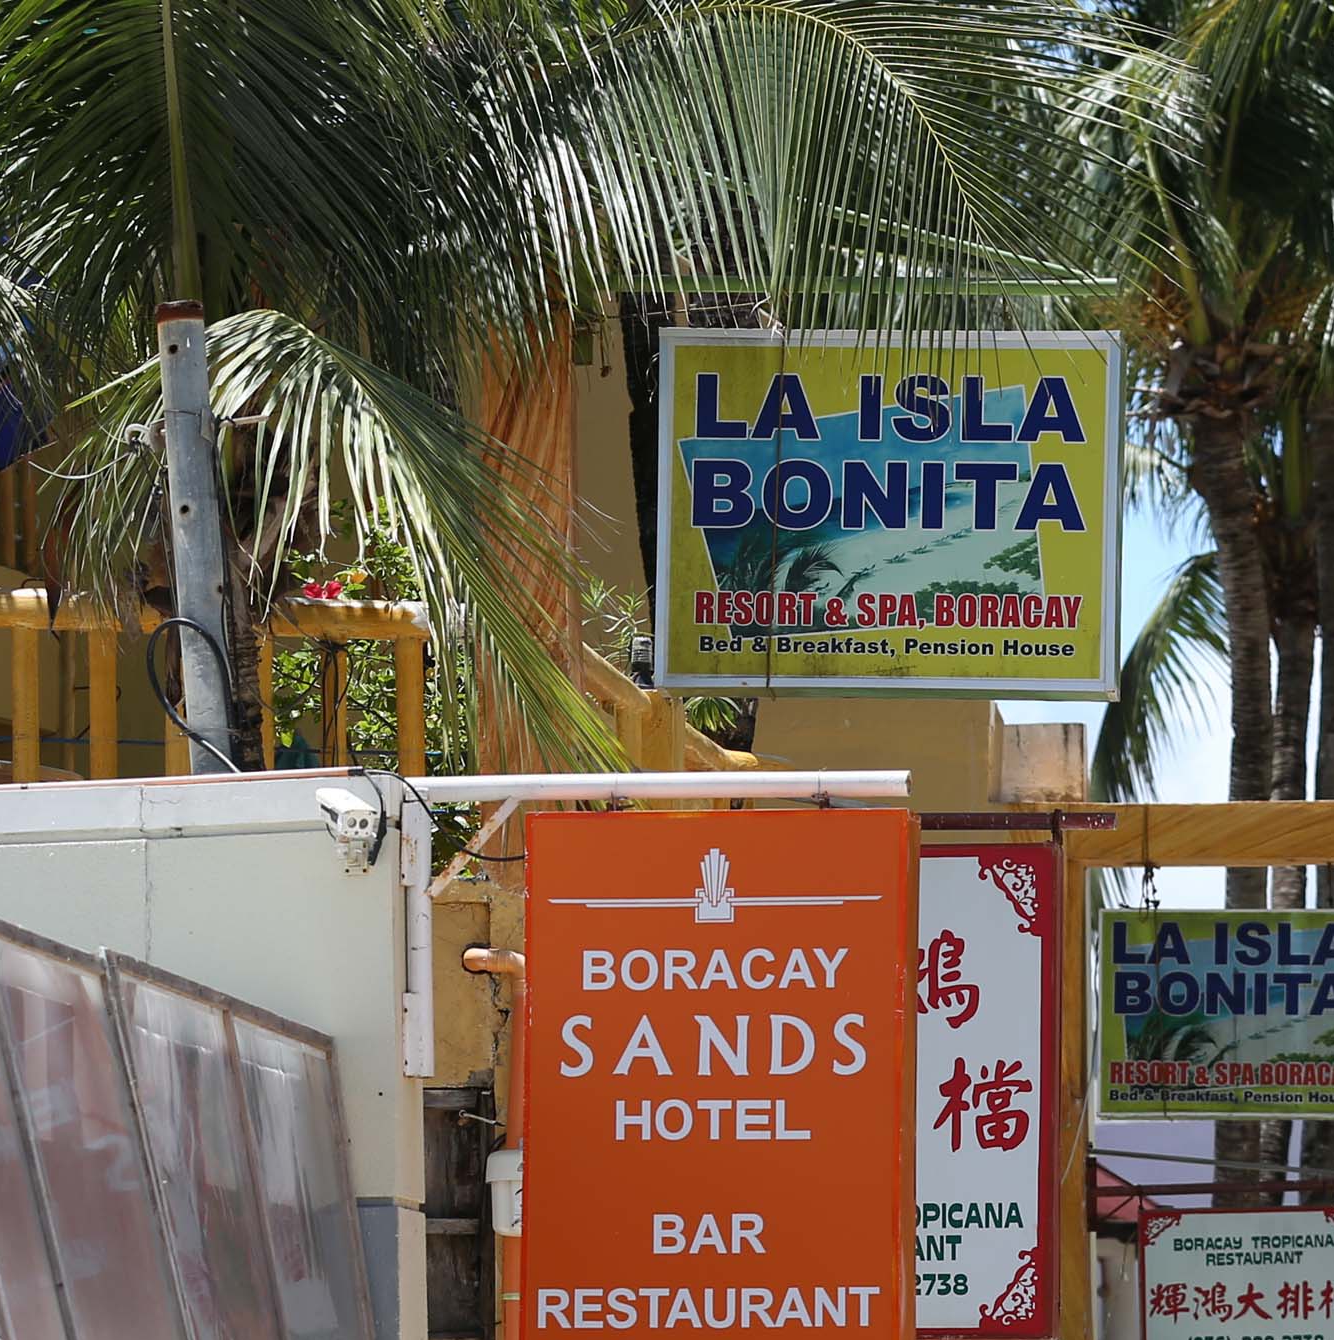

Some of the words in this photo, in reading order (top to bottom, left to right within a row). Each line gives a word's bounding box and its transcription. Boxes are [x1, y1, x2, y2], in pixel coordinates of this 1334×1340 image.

[695, 373, 820, 441] LA
[859, 373, 1086, 443] ISLA
[692, 459, 1086, 532] BONITA
[694, 591, 818, 626] RESORT
[824, 596, 847, 627] &
[857, 593, 926, 630] SPA,
[932, 595, 1082, 628] BORACAY
[699, 636, 742, 652] Bed
[751, 637, 767, 653] &
[776, 637, 896, 657] Breakfast,
[904, 639, 995, 657] Pension
[1002, 640, 1075, 657] House
[1113, 922, 1189, 965] LA
[583, 948, 848, 991] BORACAY
[560, 1013, 867, 1078] SANDS
[1110, 1061, 1189, 1086] RESORT
[1195, 1064, 1209, 1085] &
[1215, 1061, 1255, 1086] SPA
[1109, 1090, 1140, 1102] Bed
[1244, 1091, 1303, 1103] Pension
[615, 1100, 811, 1141] HOTEL
[653, 1213, 765, 1254] BAR
[1173, 1236, 1243, 1251] BORACAY
[1251, 1234, 1334, 1249] TROPICANA
[1206, 1251, 1303, 1266] RESTAURANT
[538, 1287, 880, 1329] RESTAURANT
